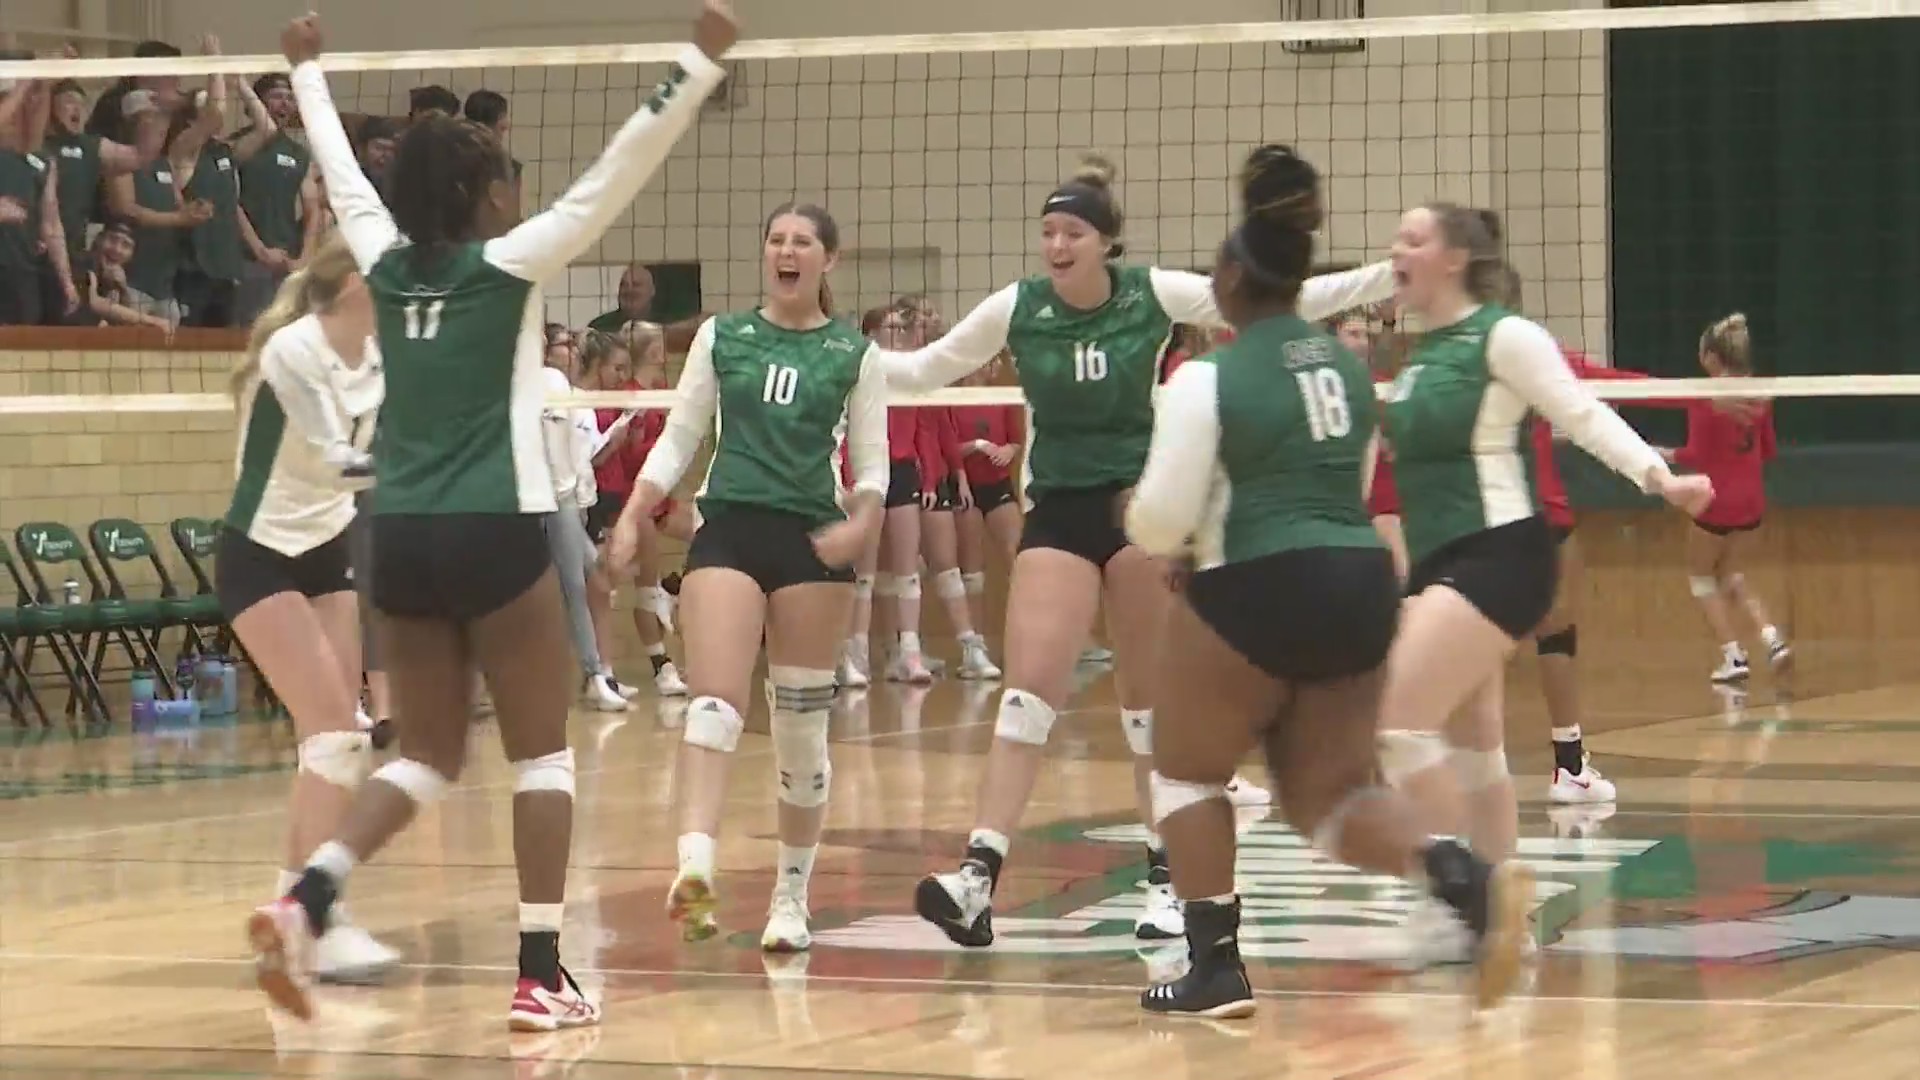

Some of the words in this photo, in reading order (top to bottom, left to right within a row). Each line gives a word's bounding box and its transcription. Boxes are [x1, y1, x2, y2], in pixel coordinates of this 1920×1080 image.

[1073, 341, 1108, 382] 16
[762, 363, 799, 406] 10
[1293, 367, 1349, 443] 18
